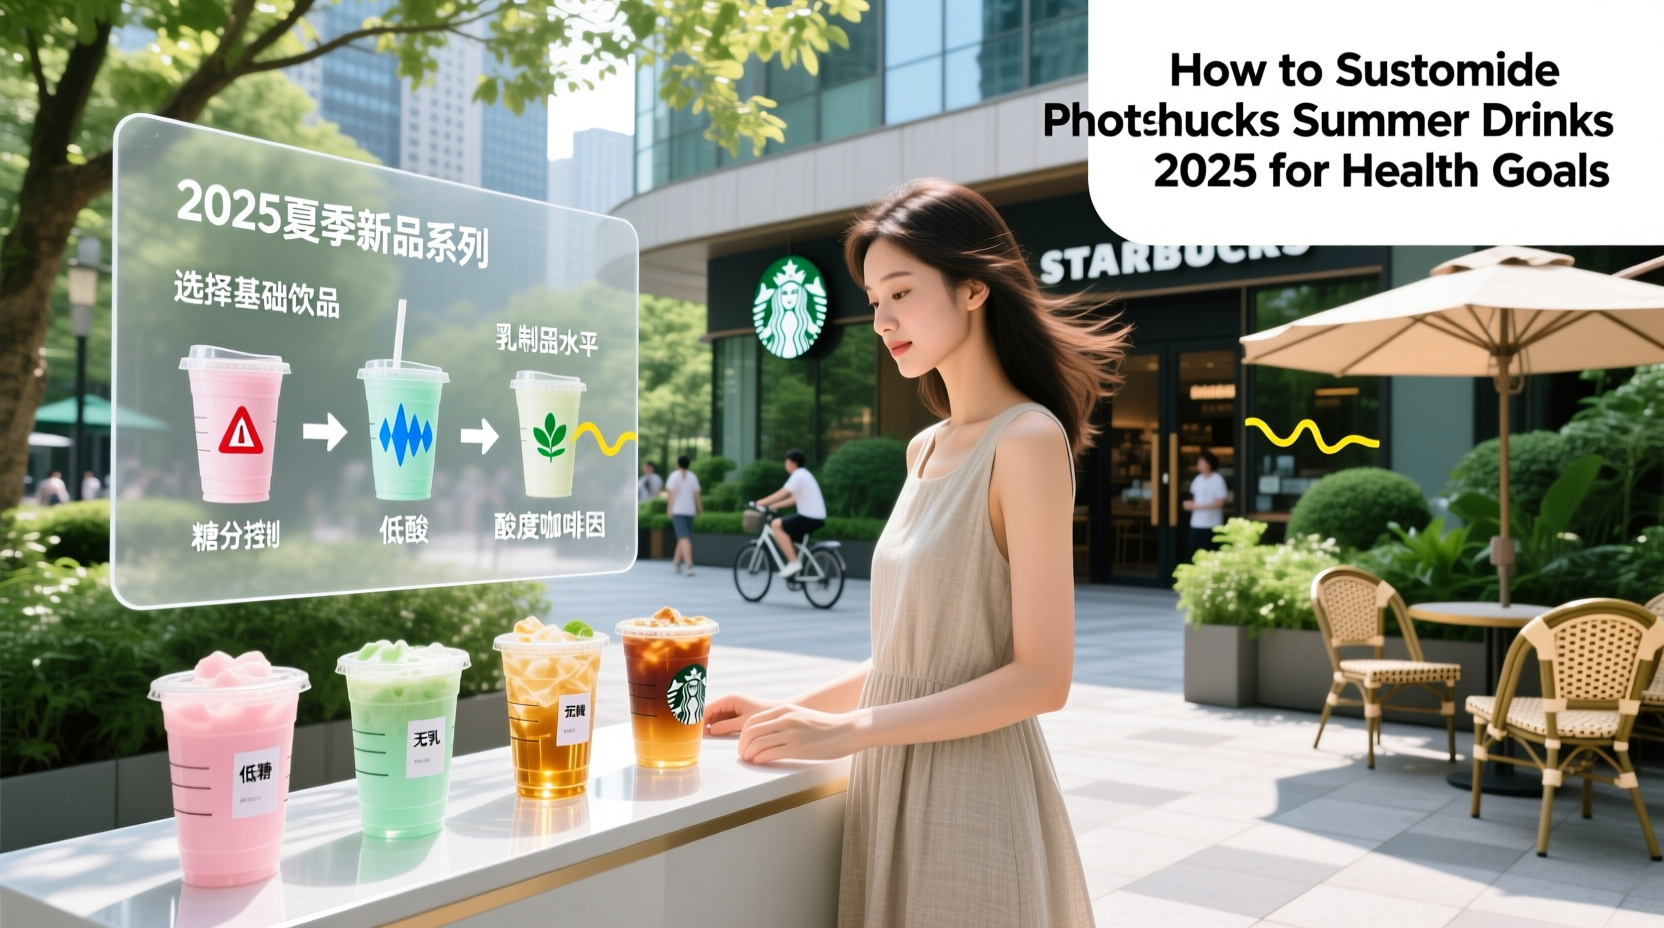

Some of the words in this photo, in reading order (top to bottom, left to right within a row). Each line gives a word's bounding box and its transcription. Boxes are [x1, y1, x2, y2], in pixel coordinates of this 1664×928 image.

[177, 178, 489, 269] 2025夏季新品系列
[173, 269, 340, 319] 选择基础饮品
[379, 513, 429, 545] 低酸
